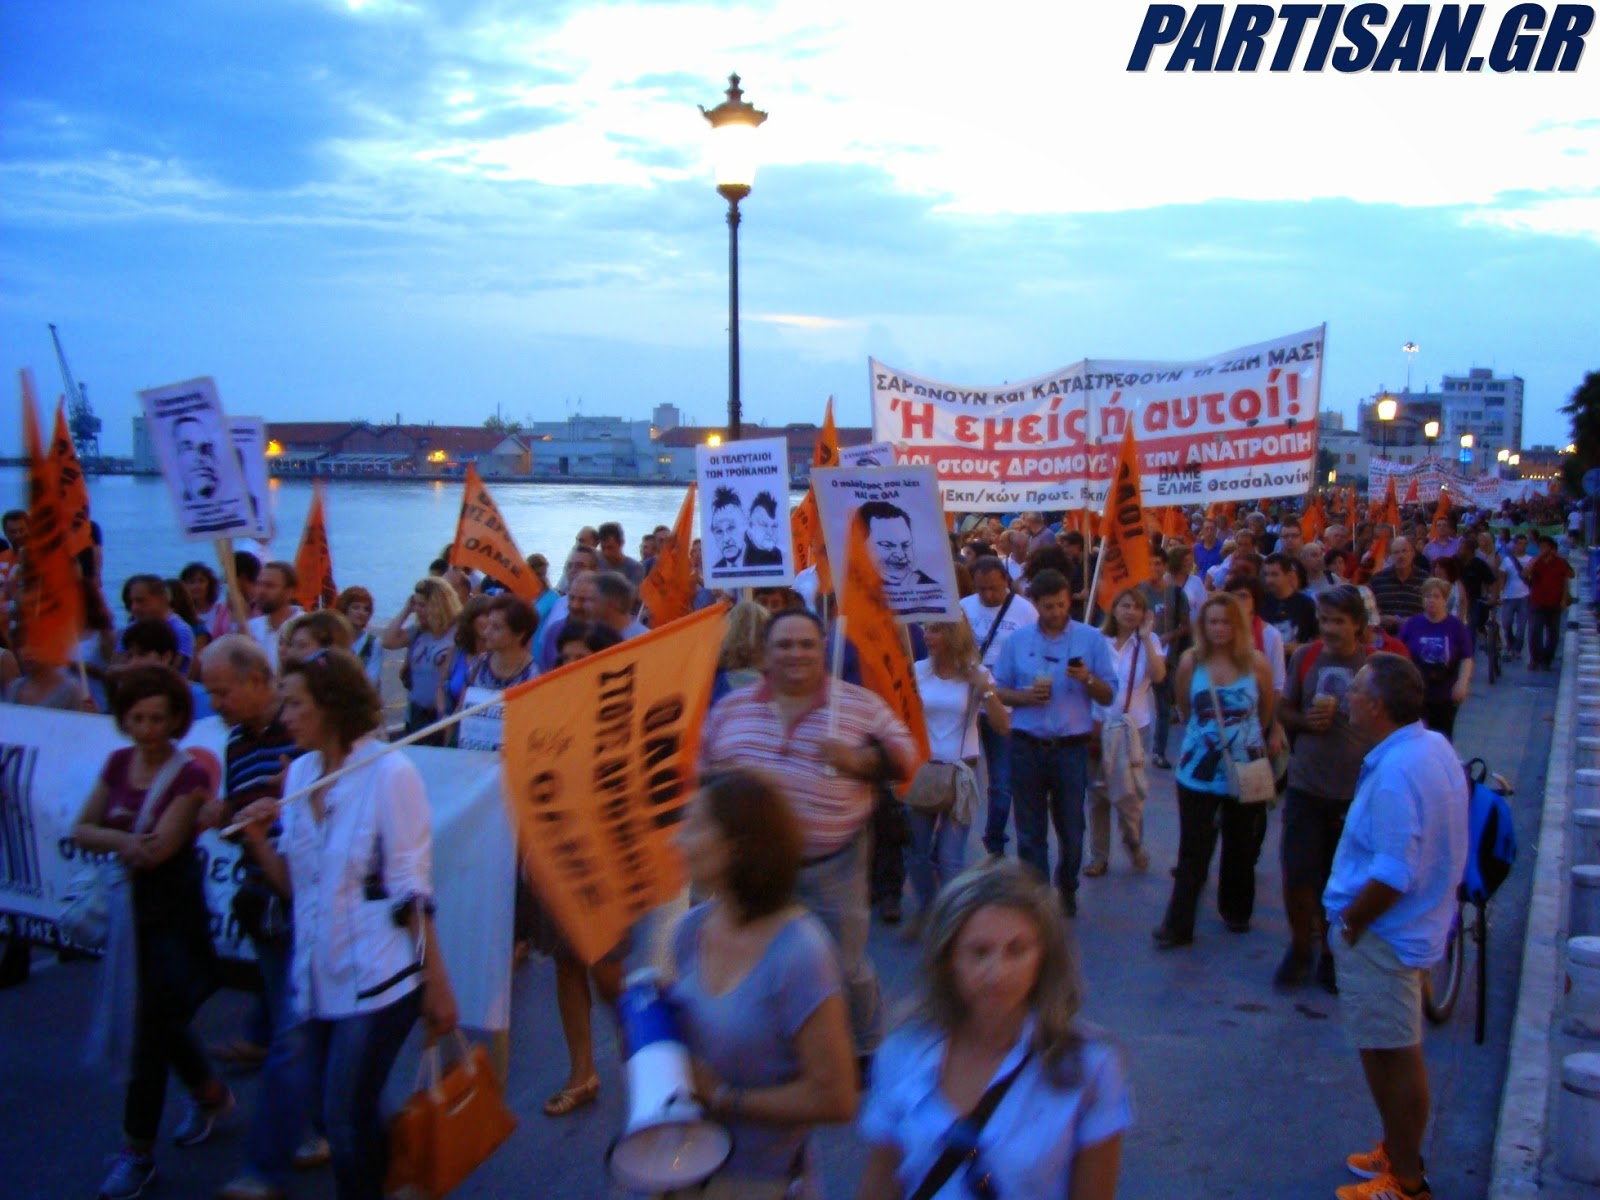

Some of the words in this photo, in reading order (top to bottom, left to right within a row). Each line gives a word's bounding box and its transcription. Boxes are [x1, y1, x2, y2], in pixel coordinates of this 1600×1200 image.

[876, 374, 987, 405] ΣΑΡΩΝΟΥΝ
[994, 391, 1025, 403] και
[1031, 369, 1183, 399] ΚΑΤΑΣΤΡΕΦΟΥΝ
[1267, 341, 1320, 367] ΜΑΣ!
[954, 397, 1088, 450] εμείς
[1101, 391, 1127, 437] ή
[1143, 368, 1300, 432] αυτοί!
[937, 458, 1000, 479] στους
[1006, 452, 1107, 476] ΔΡΟΜΟΥΣ
[1186, 431, 1312, 465] ΑΝΑΤΡΟΠΗ
[1157, 481, 1202, 496] ΕΛΜΕ
